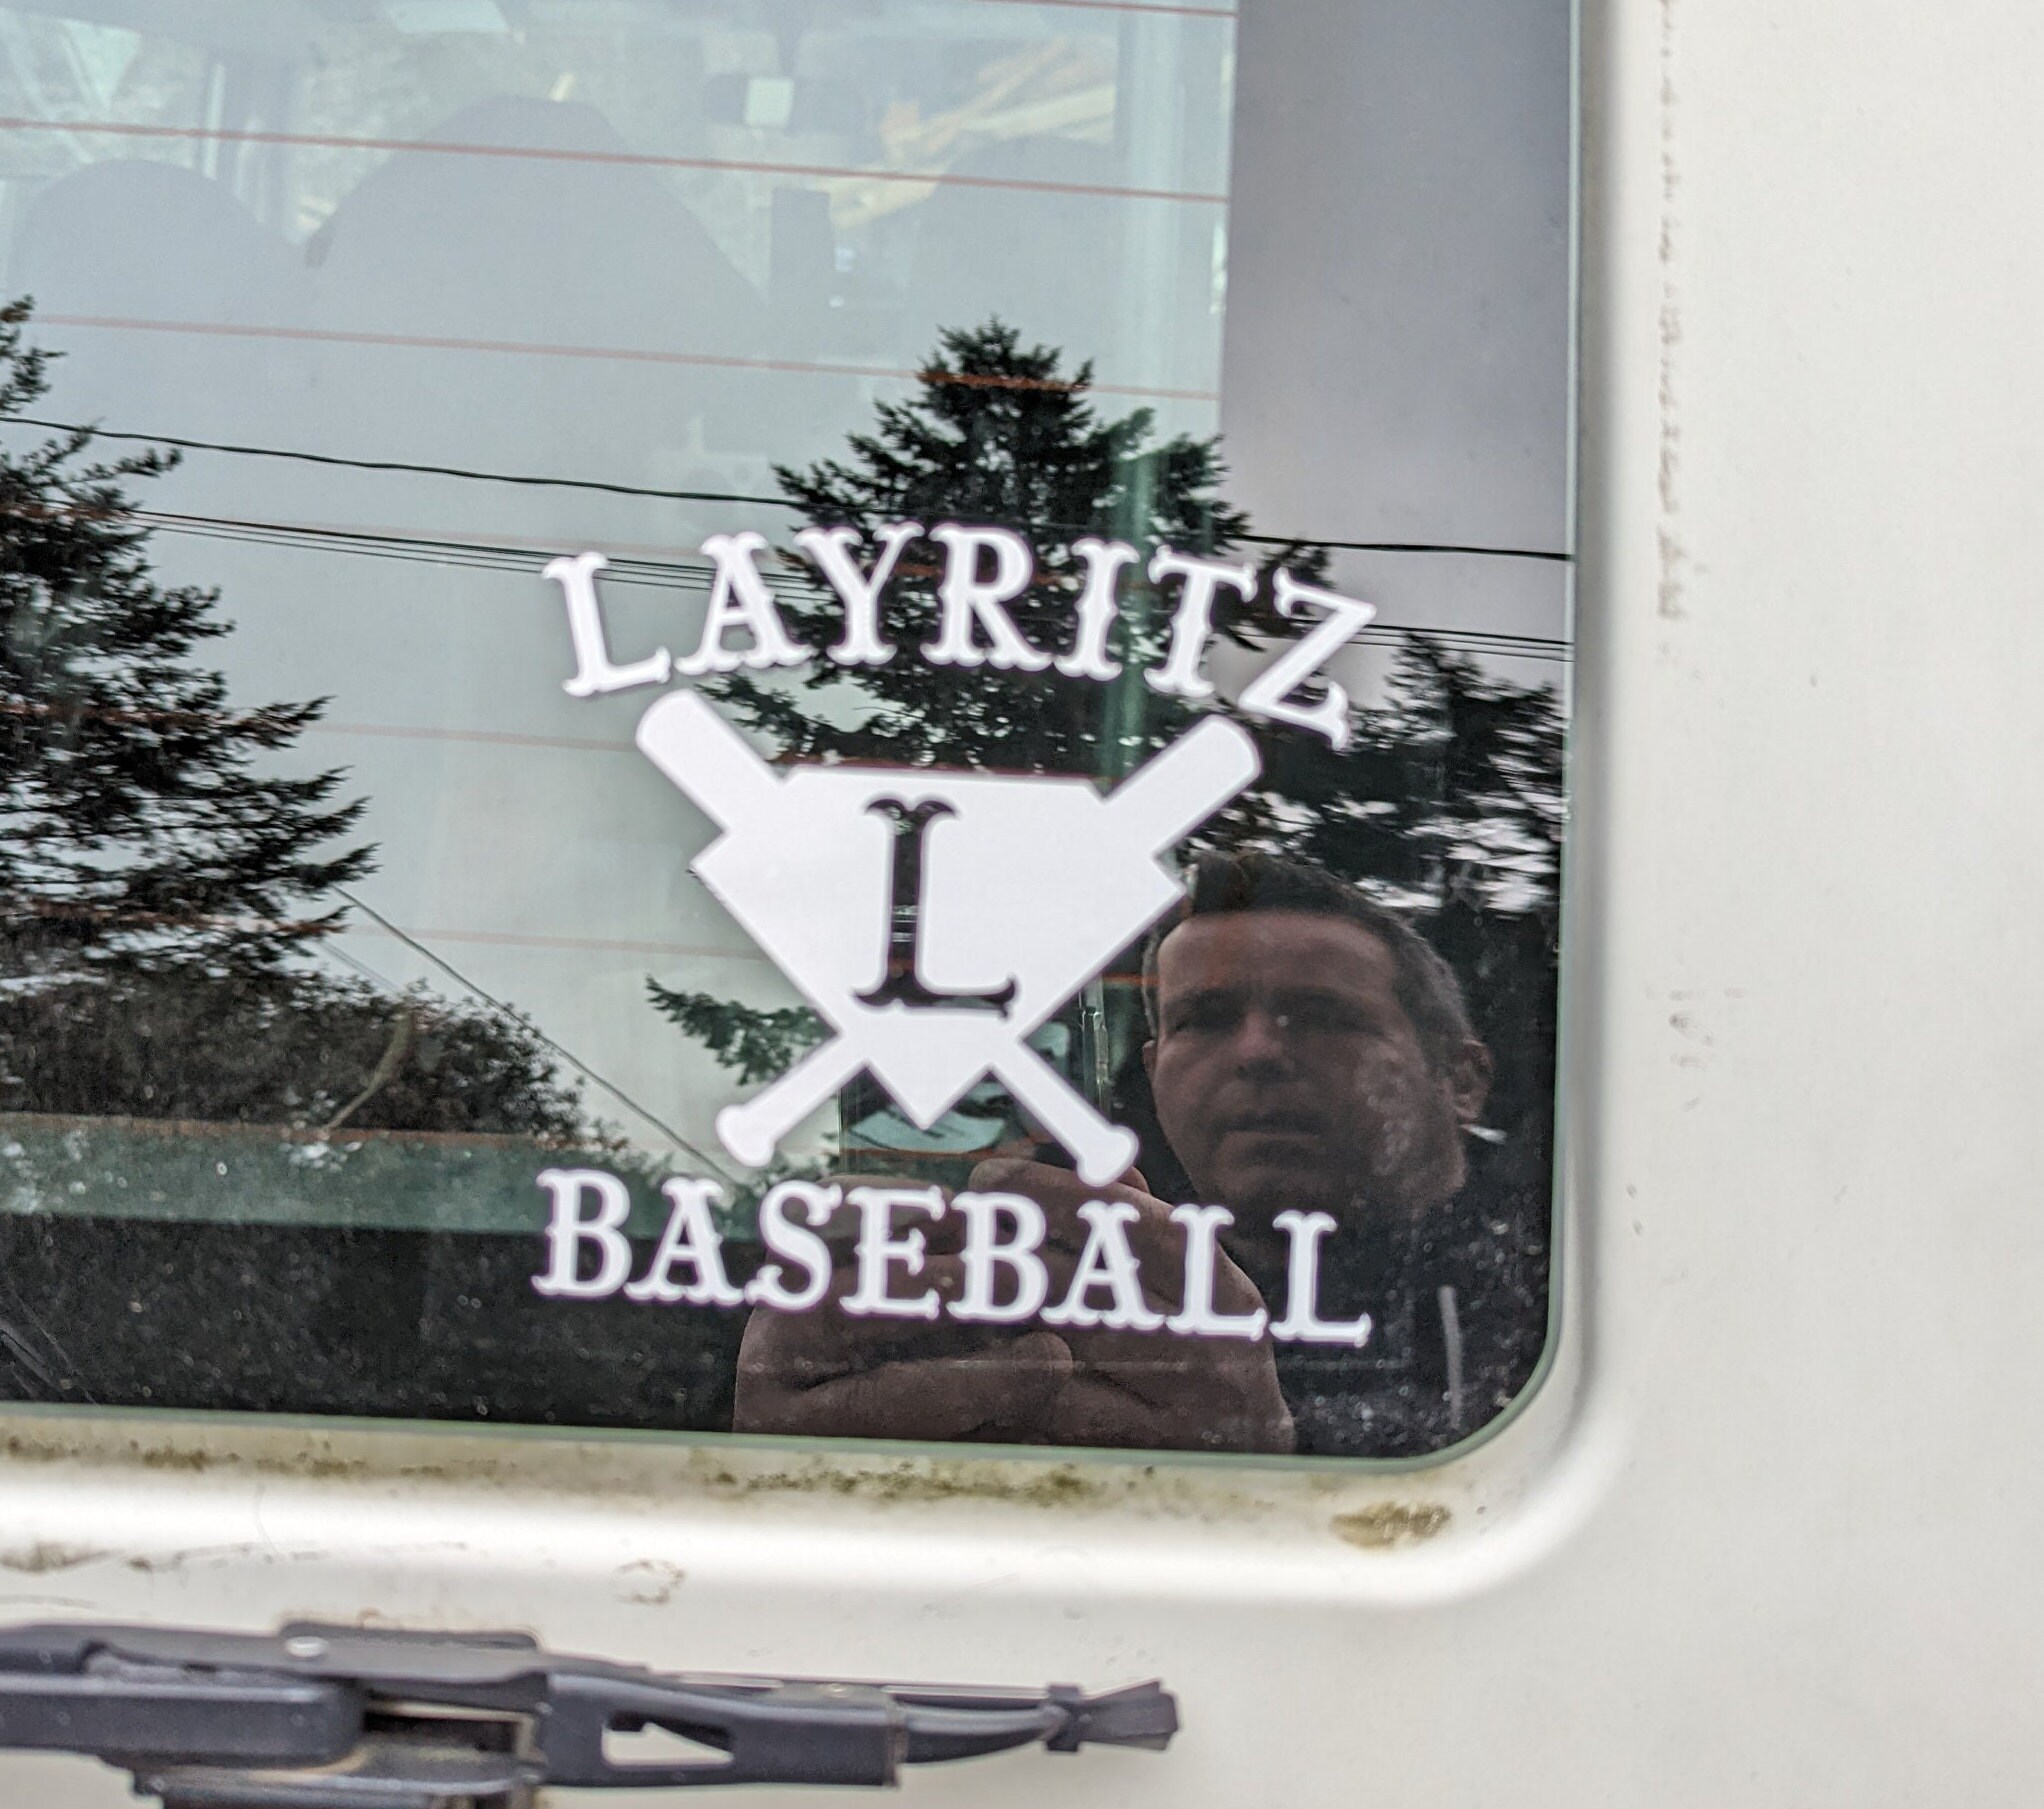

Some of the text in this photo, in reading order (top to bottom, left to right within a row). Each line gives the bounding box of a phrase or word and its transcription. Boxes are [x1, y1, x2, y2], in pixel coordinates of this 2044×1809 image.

[541, 524, 1378, 750] LAYRITZ
[851, 795, 1017, 1015] L
[533, 1168, 1372, 1348] BASEBALL
